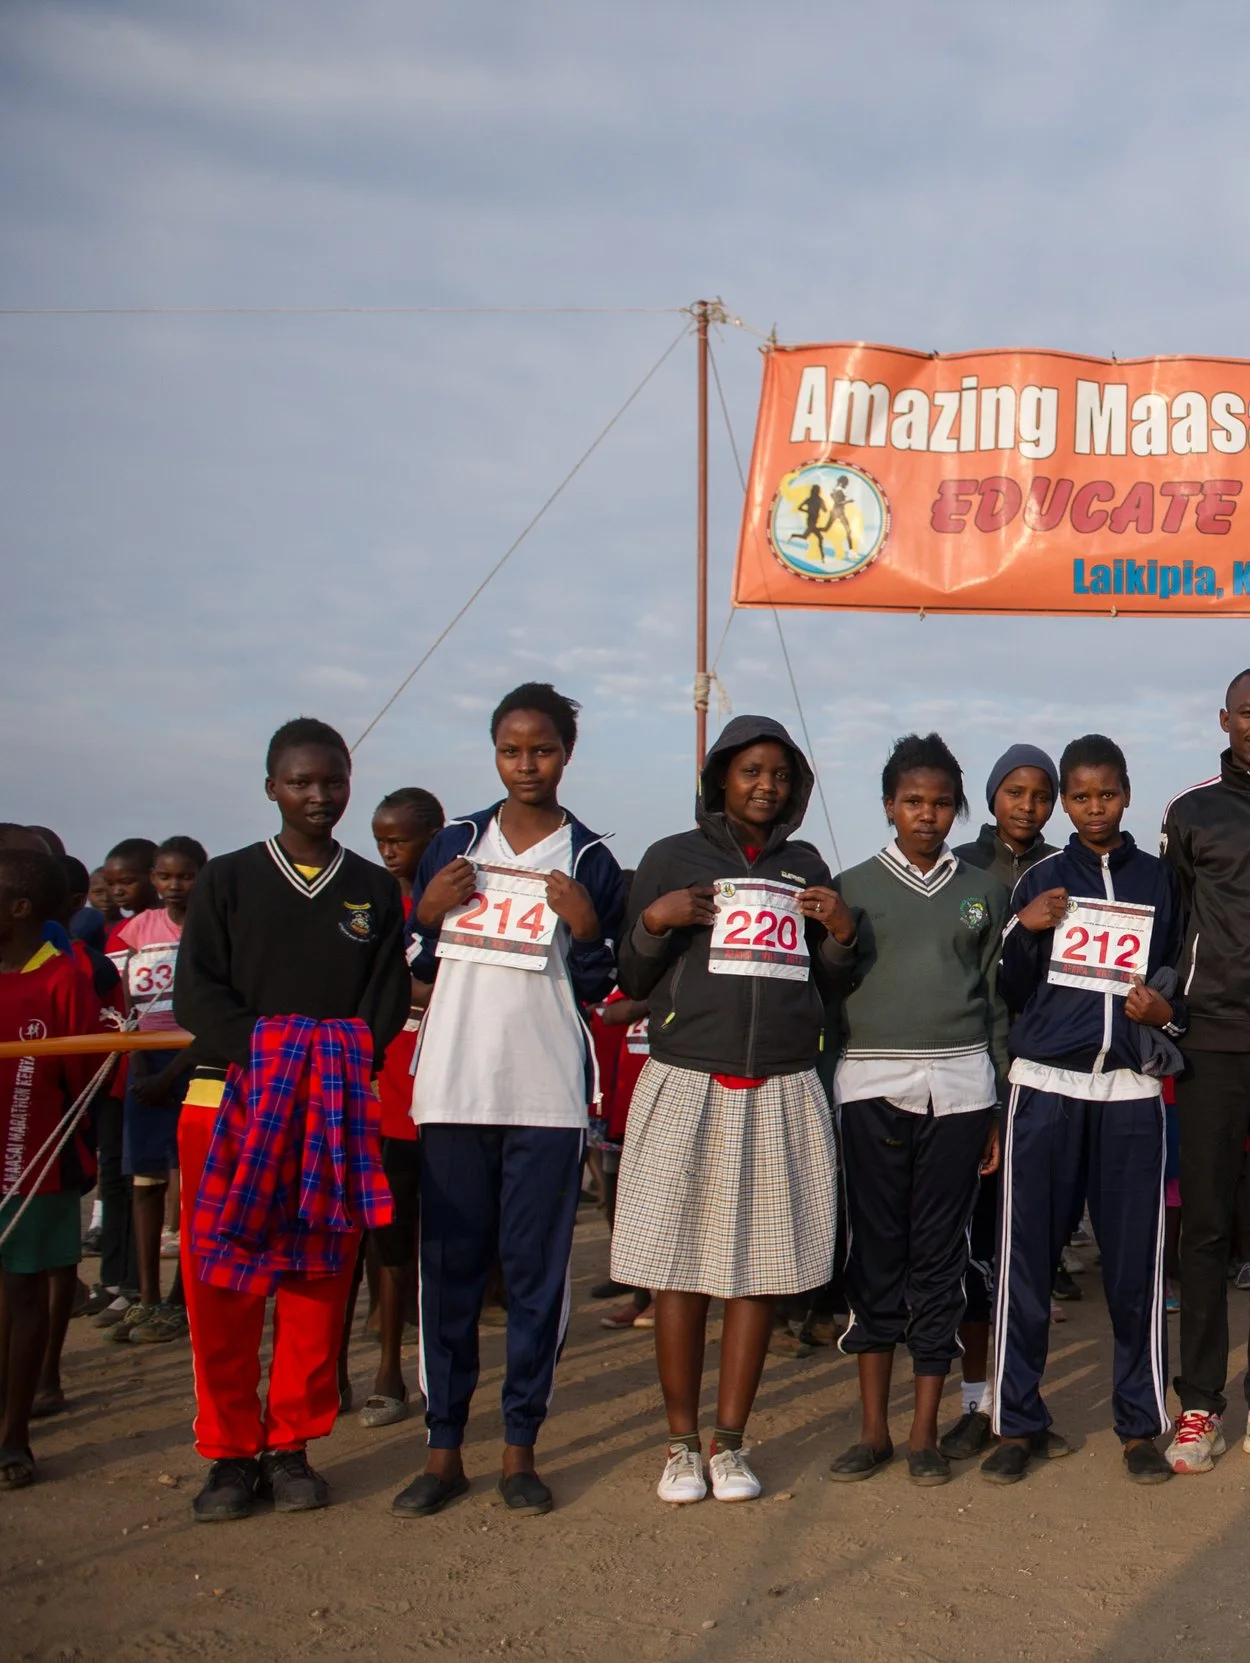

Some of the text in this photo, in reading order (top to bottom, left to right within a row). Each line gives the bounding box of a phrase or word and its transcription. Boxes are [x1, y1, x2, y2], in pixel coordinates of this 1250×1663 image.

[789, 365, 1059, 459] Amazing
[930, 476, 1243, 535] EDUCATE
[1072, 558, 1224, 600] Laikipia,
[455, 891, 546, 940] 214
[723, 910, 798, 951] 220
[1062, 926, 1141, 969] 212
[8, 1088, 32, 1142] MARATHON
